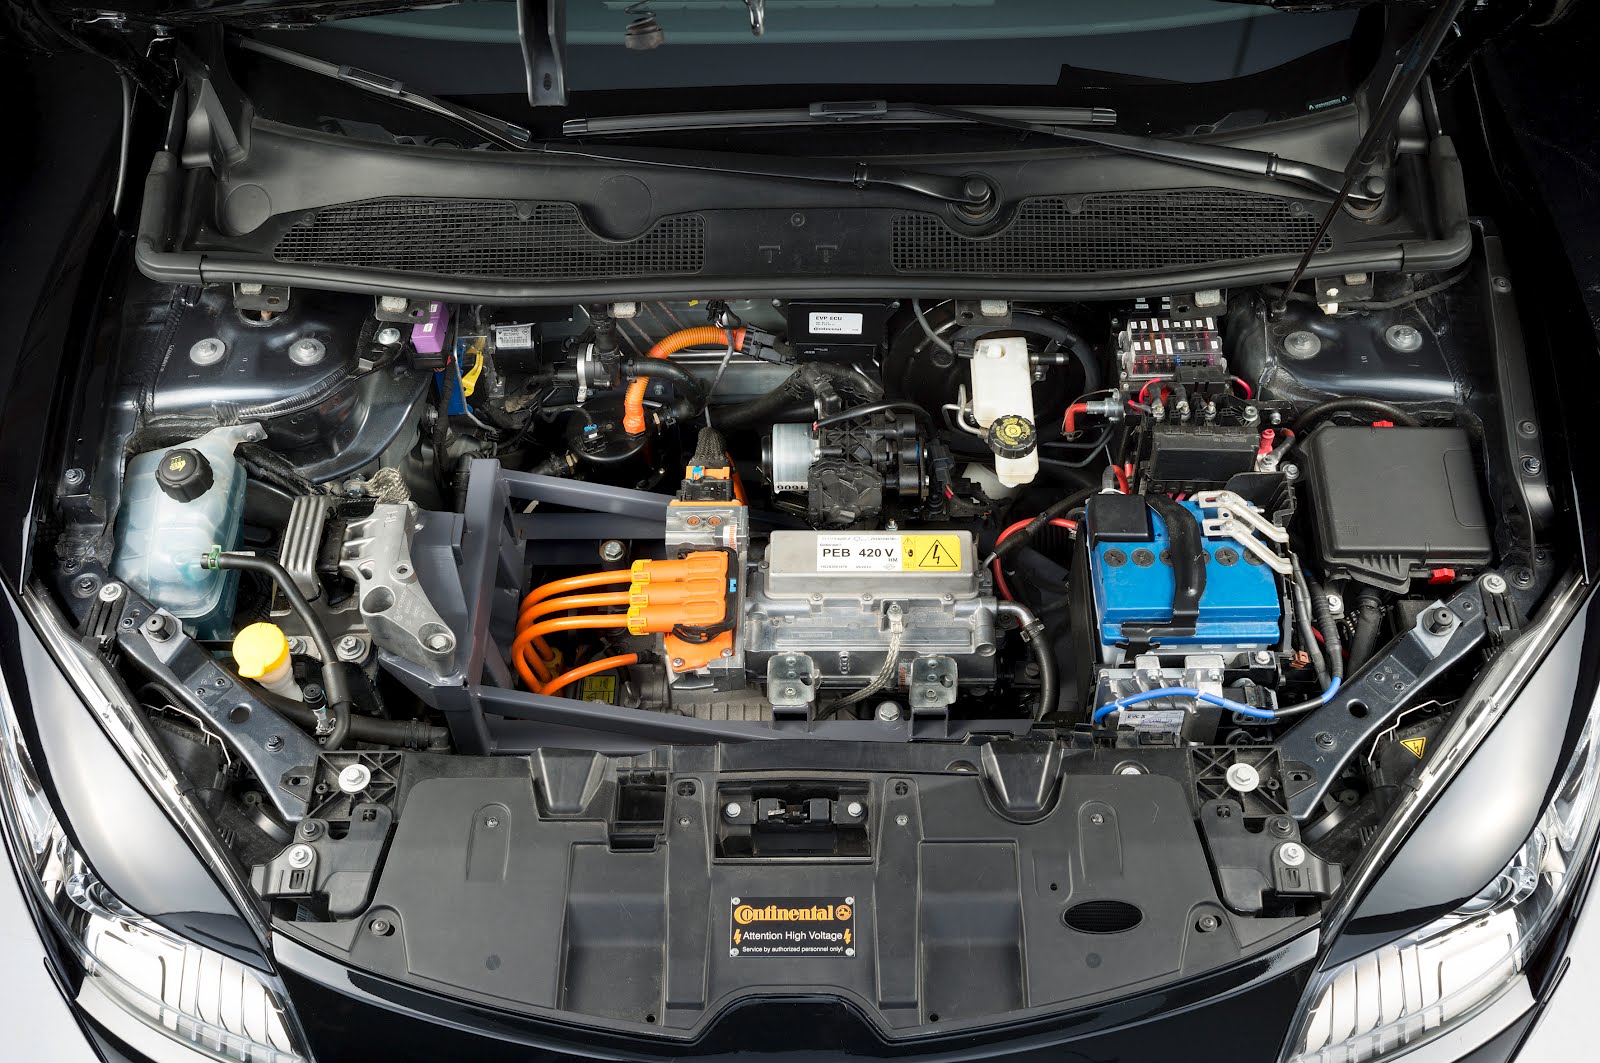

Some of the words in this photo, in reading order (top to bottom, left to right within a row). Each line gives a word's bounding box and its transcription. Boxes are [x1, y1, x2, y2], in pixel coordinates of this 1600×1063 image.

[822, 548, 851, 558] PEB
[858, 548, 882, 558] 420
[884, 548, 894, 558] V
[734, 904, 834, 925] Continental
[743, 931, 783, 940] Attention
[785, 931, 807, 942] High
[808, 931, 843, 942] Voltage
